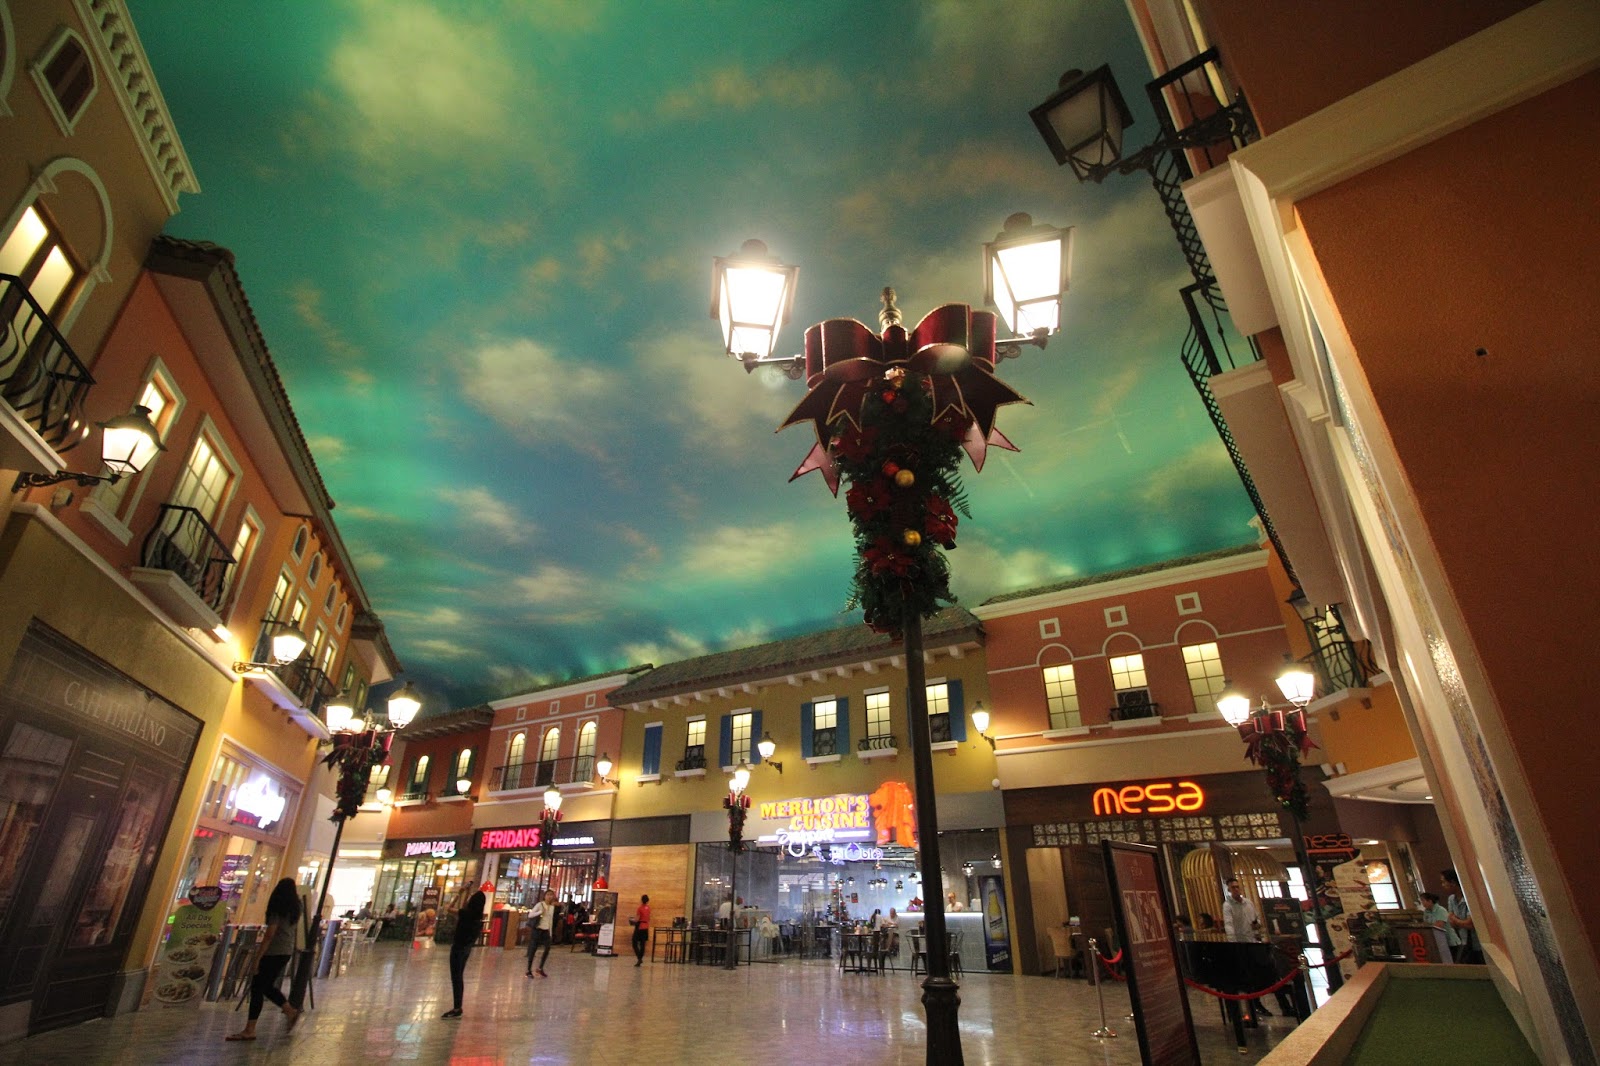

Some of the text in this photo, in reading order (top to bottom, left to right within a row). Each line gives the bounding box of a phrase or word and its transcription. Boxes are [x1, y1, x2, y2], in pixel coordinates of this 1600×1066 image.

[104, 701, 166, 746] ITALIANO
[760, 795, 869, 820] MERLION'S
[1093, 782, 1204, 815] mesa
[790, 811, 869, 831] CUISINE
[487, 828, 540, 849] FRIDAYS
[180, 922, 212, 930] Specials
[197, 914, 212, 922] Day
